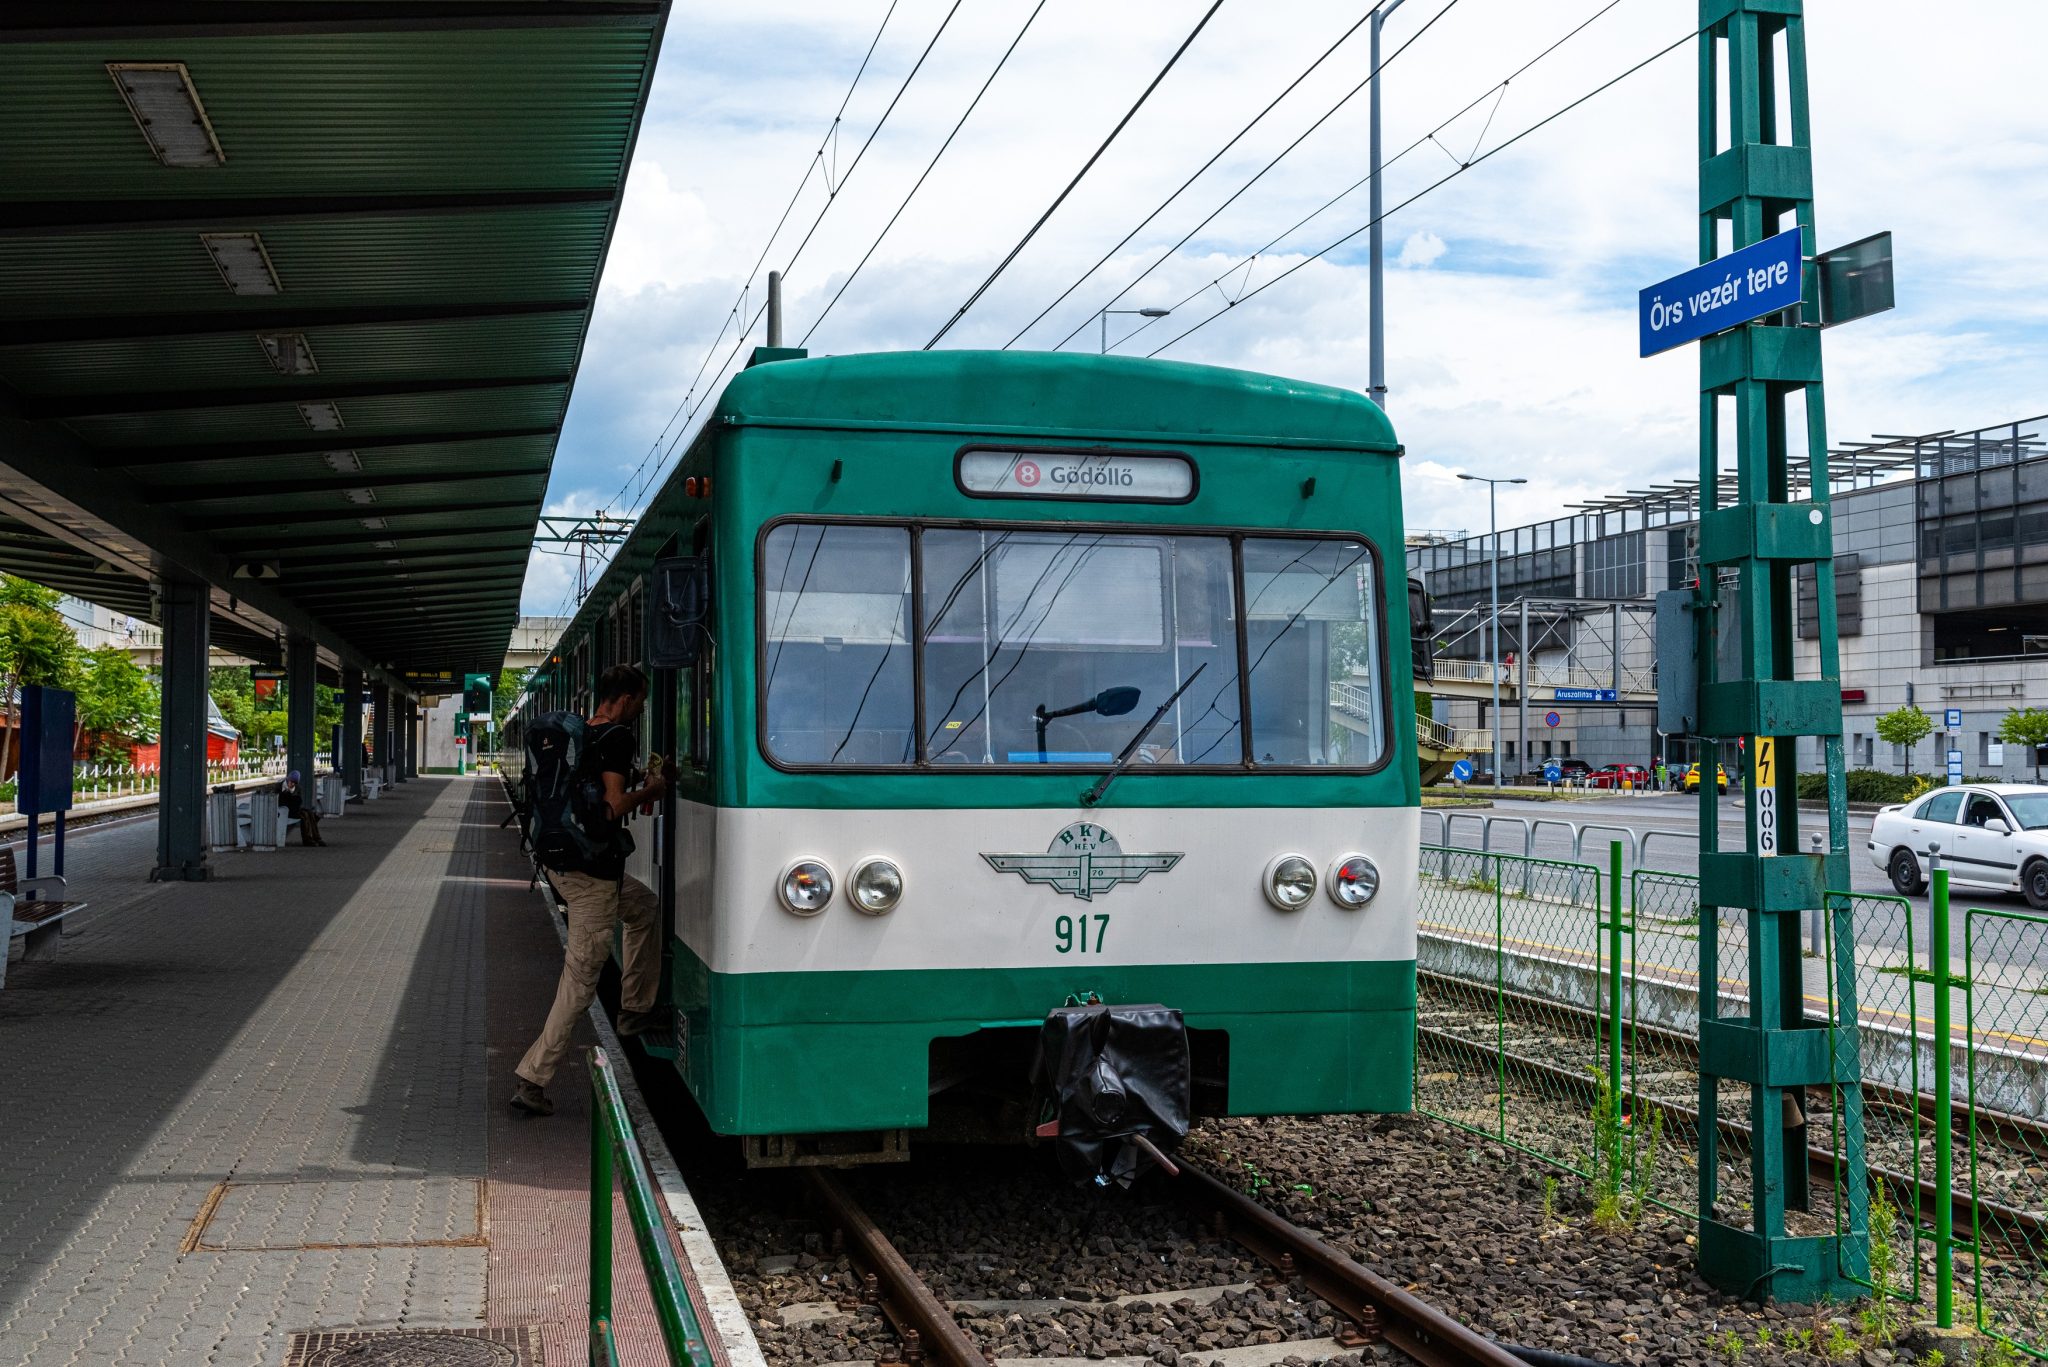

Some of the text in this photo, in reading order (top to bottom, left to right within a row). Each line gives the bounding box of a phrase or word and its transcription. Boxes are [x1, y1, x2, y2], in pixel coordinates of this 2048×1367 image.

[1650, 260, 1788, 331] Örs vezér tere
[1021, 465, 1133, 486] 8 Gödöllő
[1059, 825, 1113, 845] BKV
[1055, 914, 1110, 953] 917
